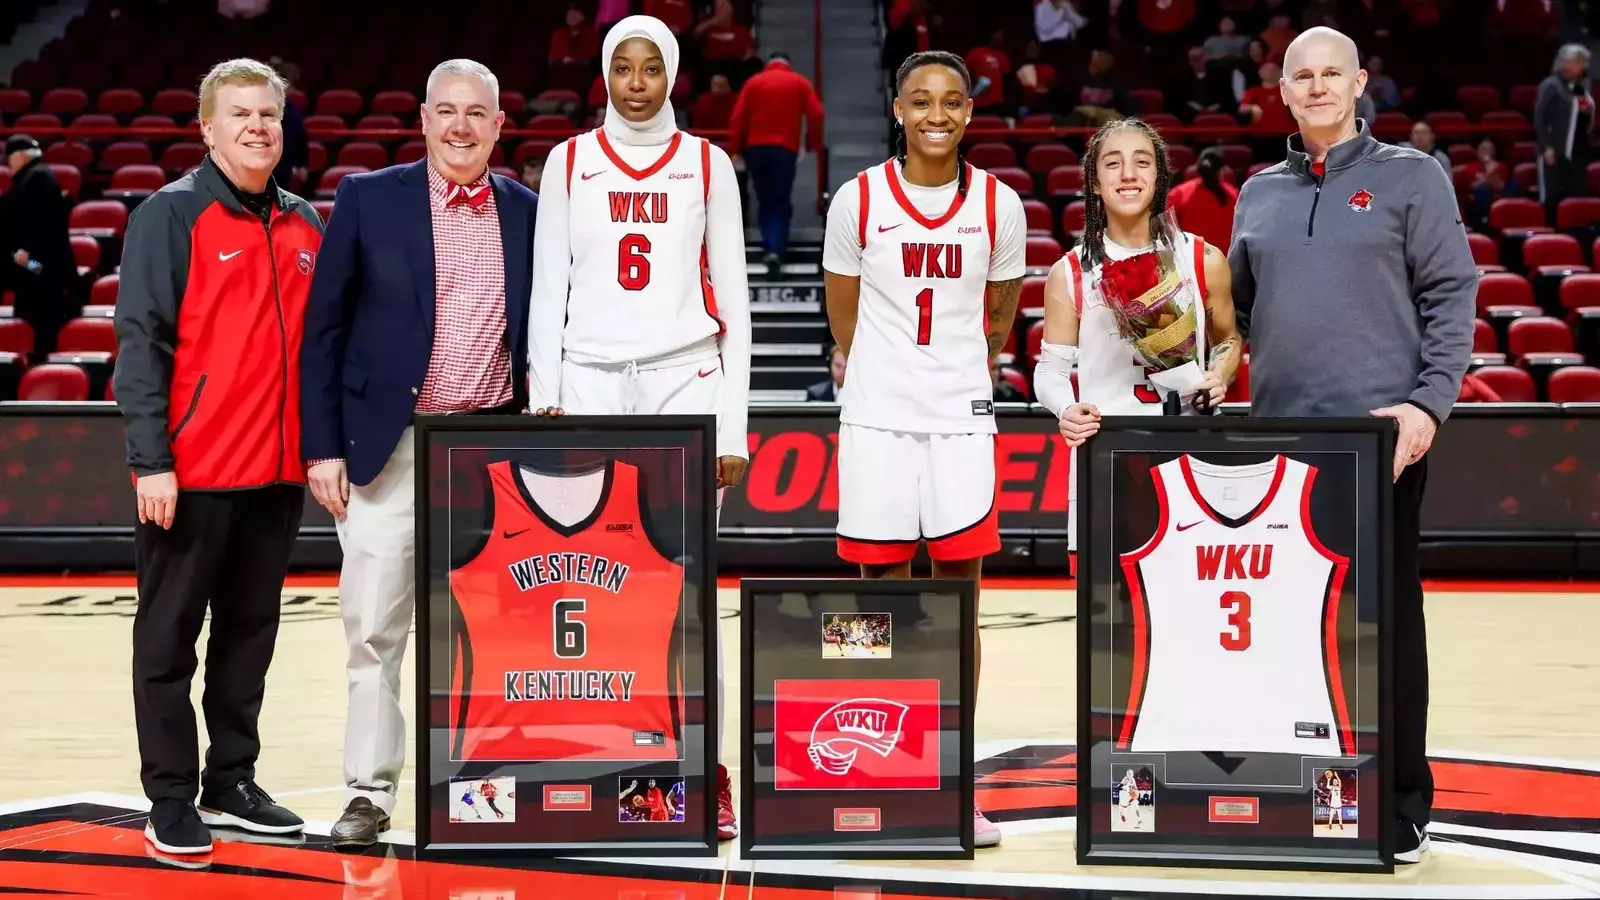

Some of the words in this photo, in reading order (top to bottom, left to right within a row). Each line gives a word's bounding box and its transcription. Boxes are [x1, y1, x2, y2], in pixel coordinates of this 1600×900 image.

[608, 191, 668, 223] WKU
[957, 226, 982, 234] C-USA
[617, 233, 651, 291] 6
[902, 243, 962, 279] WKU
[757, 287, 801, 302] SEC.
[915, 288, 934, 345] 1
[508, 552, 630, 594] WESTERN
[1196, 544, 1274, 581] WKU
[553, 598, 587, 659] 6
[1220, 590, 1252, 652] 3
[505, 670, 636, 702] KENTUCKY
[835, 709, 887, 736] WKU
